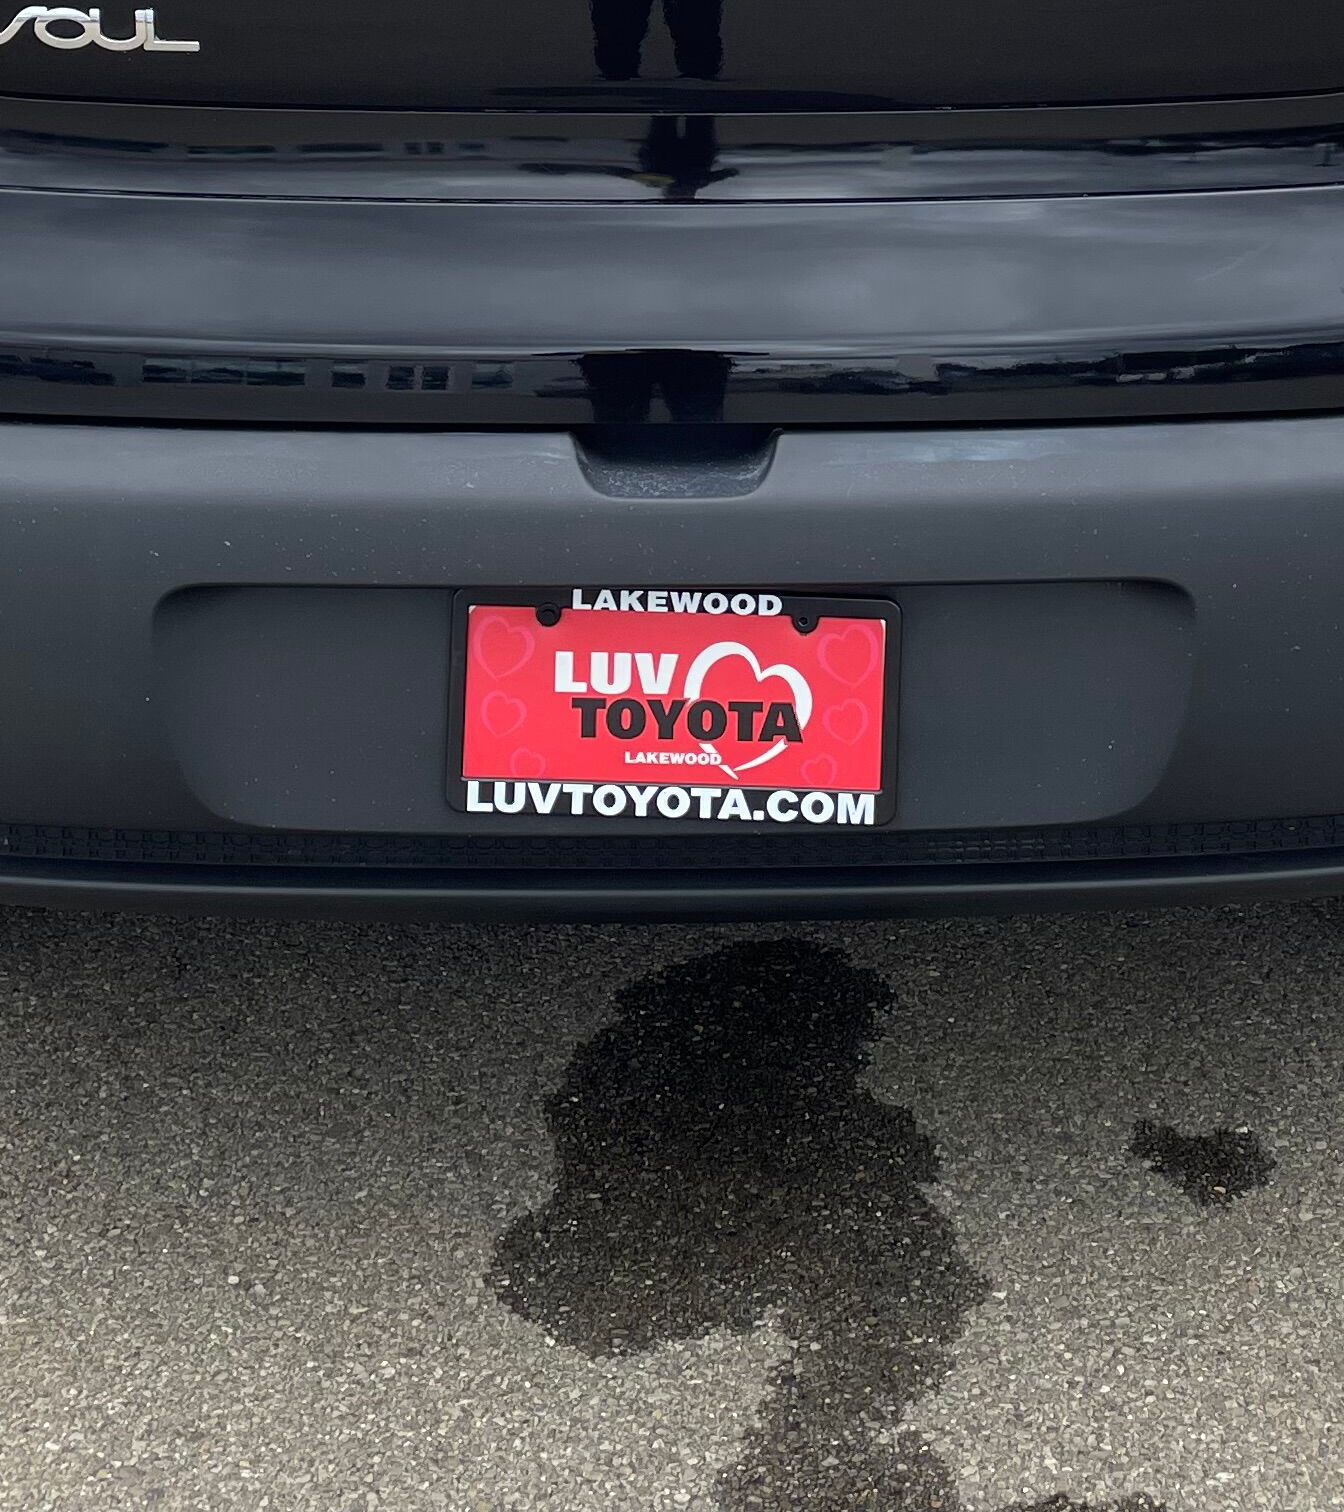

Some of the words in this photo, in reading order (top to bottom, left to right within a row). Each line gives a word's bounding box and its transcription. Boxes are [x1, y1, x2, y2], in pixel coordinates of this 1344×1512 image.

[571, 588, 783, 616] LAKEWOOD
[554, 650, 679, 696] LUV
[571, 696, 802, 744] TOYOTA
[624, 751, 722, 766] LAKEWOOD
[465, 780, 876, 826] LUVTOYOTA.COM
